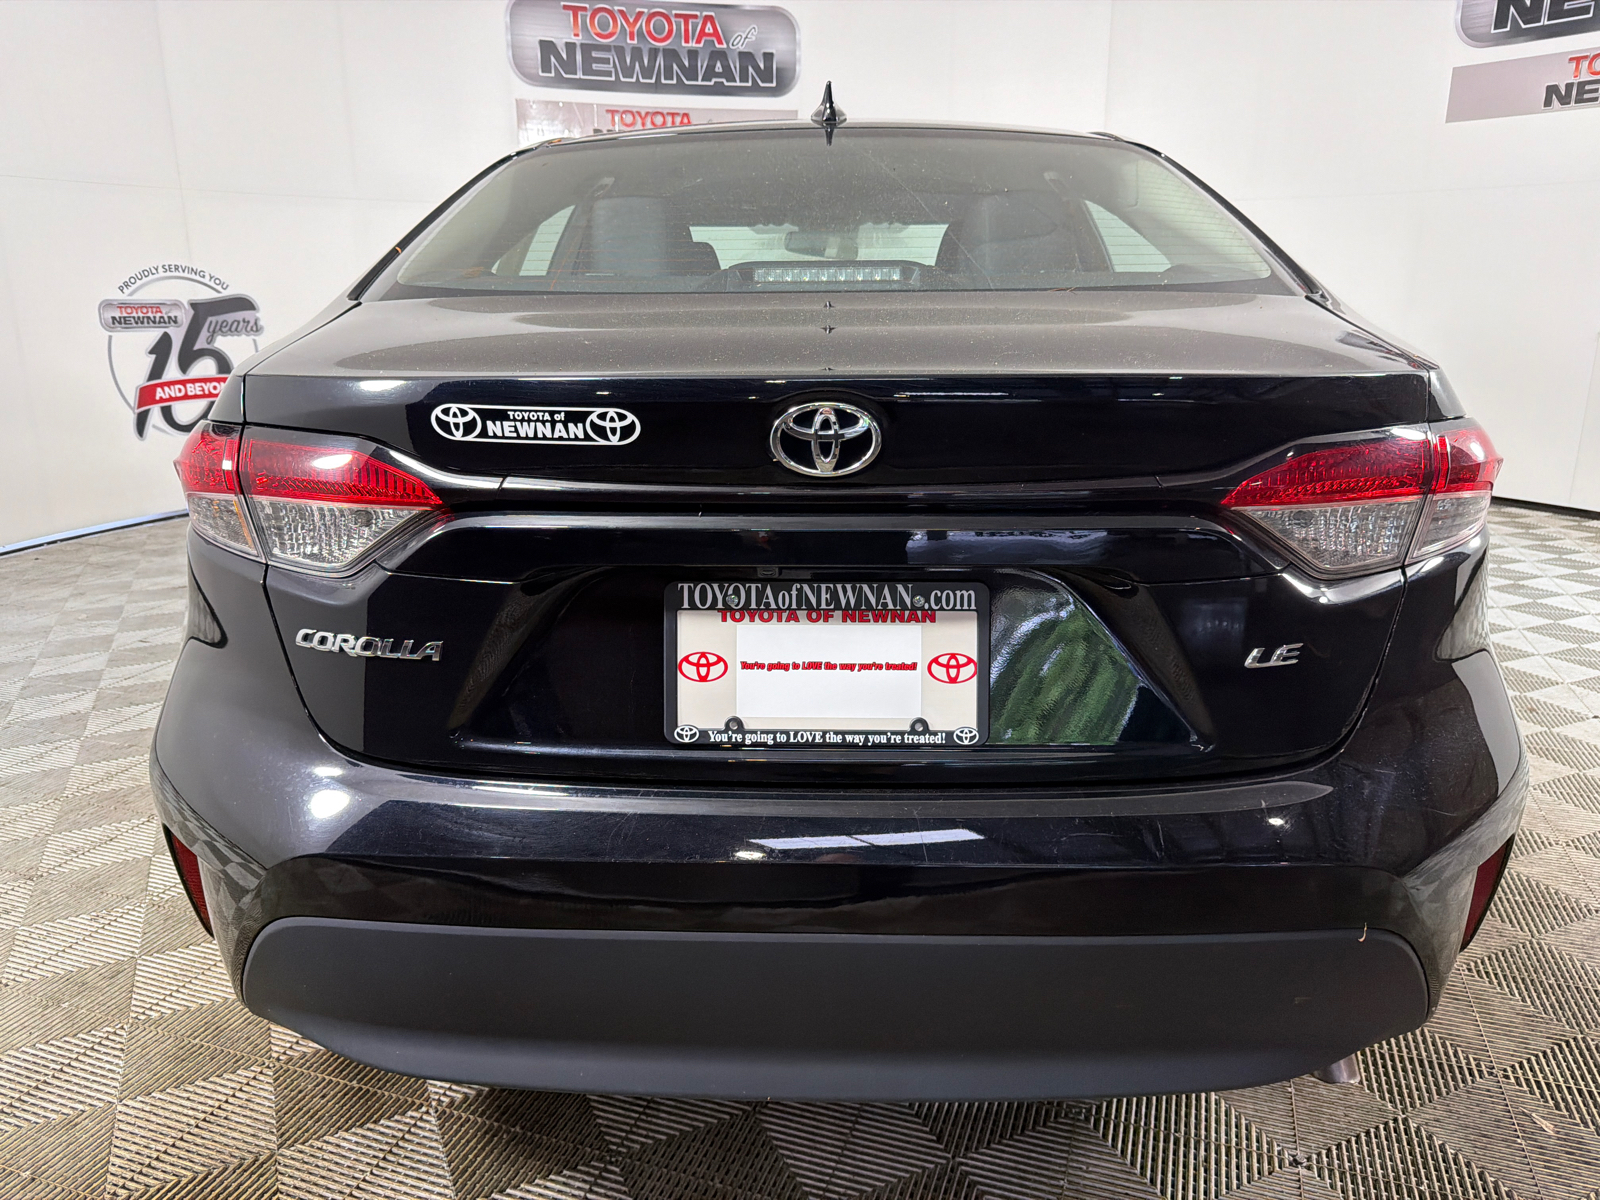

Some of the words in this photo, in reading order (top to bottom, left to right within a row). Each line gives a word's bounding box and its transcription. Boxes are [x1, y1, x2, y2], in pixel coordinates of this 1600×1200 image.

[562, 4, 725, 47] TOYOTA
[730, 26, 757, 49] of
[538, 40, 776, 87] NEWNAN
[605, 109, 692, 129] TOYOTA
[117, 265, 160, 294] PROUDLY
[161, 264, 206, 279] SERVING
[208, 273, 230, 291] YOU
[117, 305, 163, 315] TOYOTA
[111, 315, 179, 326] NEWNAN
[206, 316, 262, 346] years
[155, 384, 186, 400] AND
[507, 411, 551, 420] TOYOTA
[554, 411, 565, 420] of
[486, 420, 585, 439] NEWNAN
[717, 609, 801, 623] TOYOTA
[806, 609, 835, 623] OF
[841, 609, 936, 623] NEWNAN
[295, 628, 444, 661] COROLLA
[1244, 642, 1304, 669] LE
[740, 661, 766, 670] You're
[767, 662, 790, 671] going
[791, 662, 801, 670] to
[802, 661, 823, 670] LOVE
[824, 661, 838, 671] the
[839, 663, 857, 672] way
[858, 662, 884, 672] you're
[885, 662, 918, 671] treated!
[708, 730, 743, 742] You're
[744, 731, 774, 745] going
[776, 732, 787, 742] to
[789, 731, 823, 743] LOVE
[825, 731, 843, 743] the
[844, 734, 866, 746] way
[867, 732, 902, 746] you're
[904, 732, 946, 744] treated!
